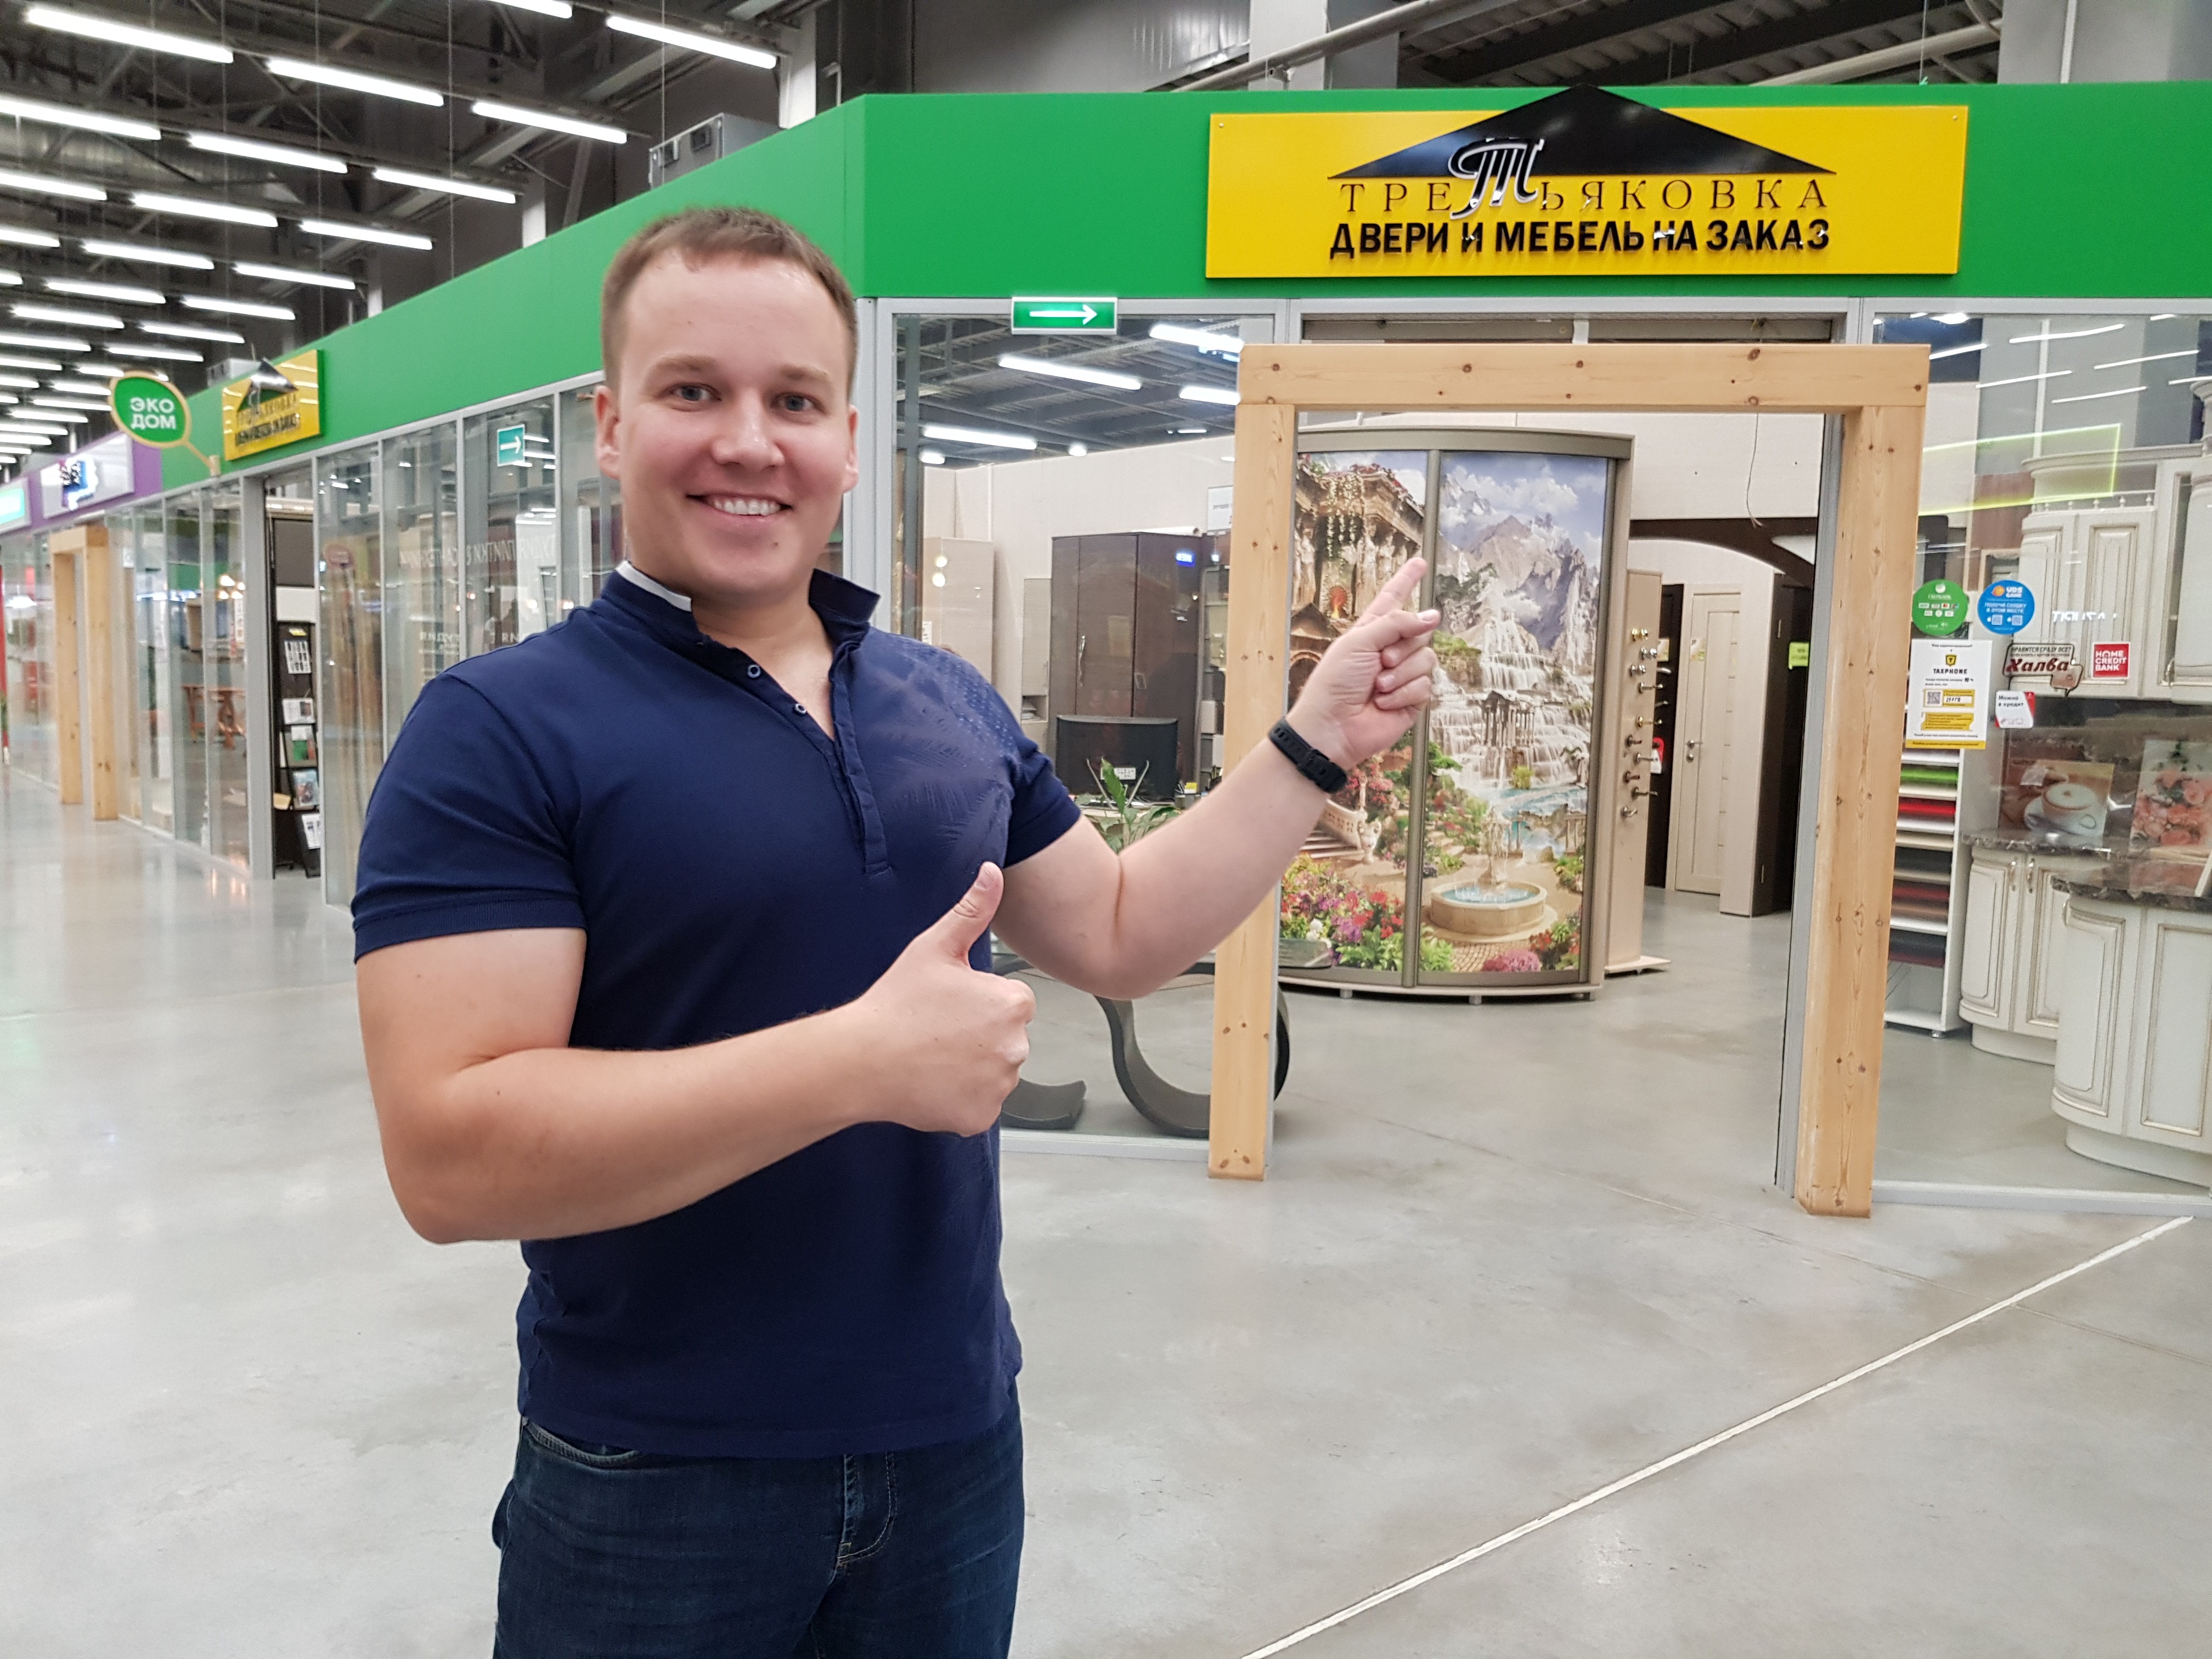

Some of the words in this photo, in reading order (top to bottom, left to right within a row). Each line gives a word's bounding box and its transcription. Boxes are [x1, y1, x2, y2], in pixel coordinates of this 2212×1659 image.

[1340, 137, 1827, 219] ТРЕТЬЯКОВКА
[1329, 222, 1449, 259] ДВЕРИ
[1460, 222, 1484, 253] И
[1495, 220, 1644, 252] МЕБЕЛЬ
[1652, 219, 1698, 251] НА
[1706, 218, 1830, 251] ЗАКАЗ
[130, 397, 175, 414] ЭКО
[131, 414, 176, 430] ДОМ
[2006, 658, 2069, 673] Халва
